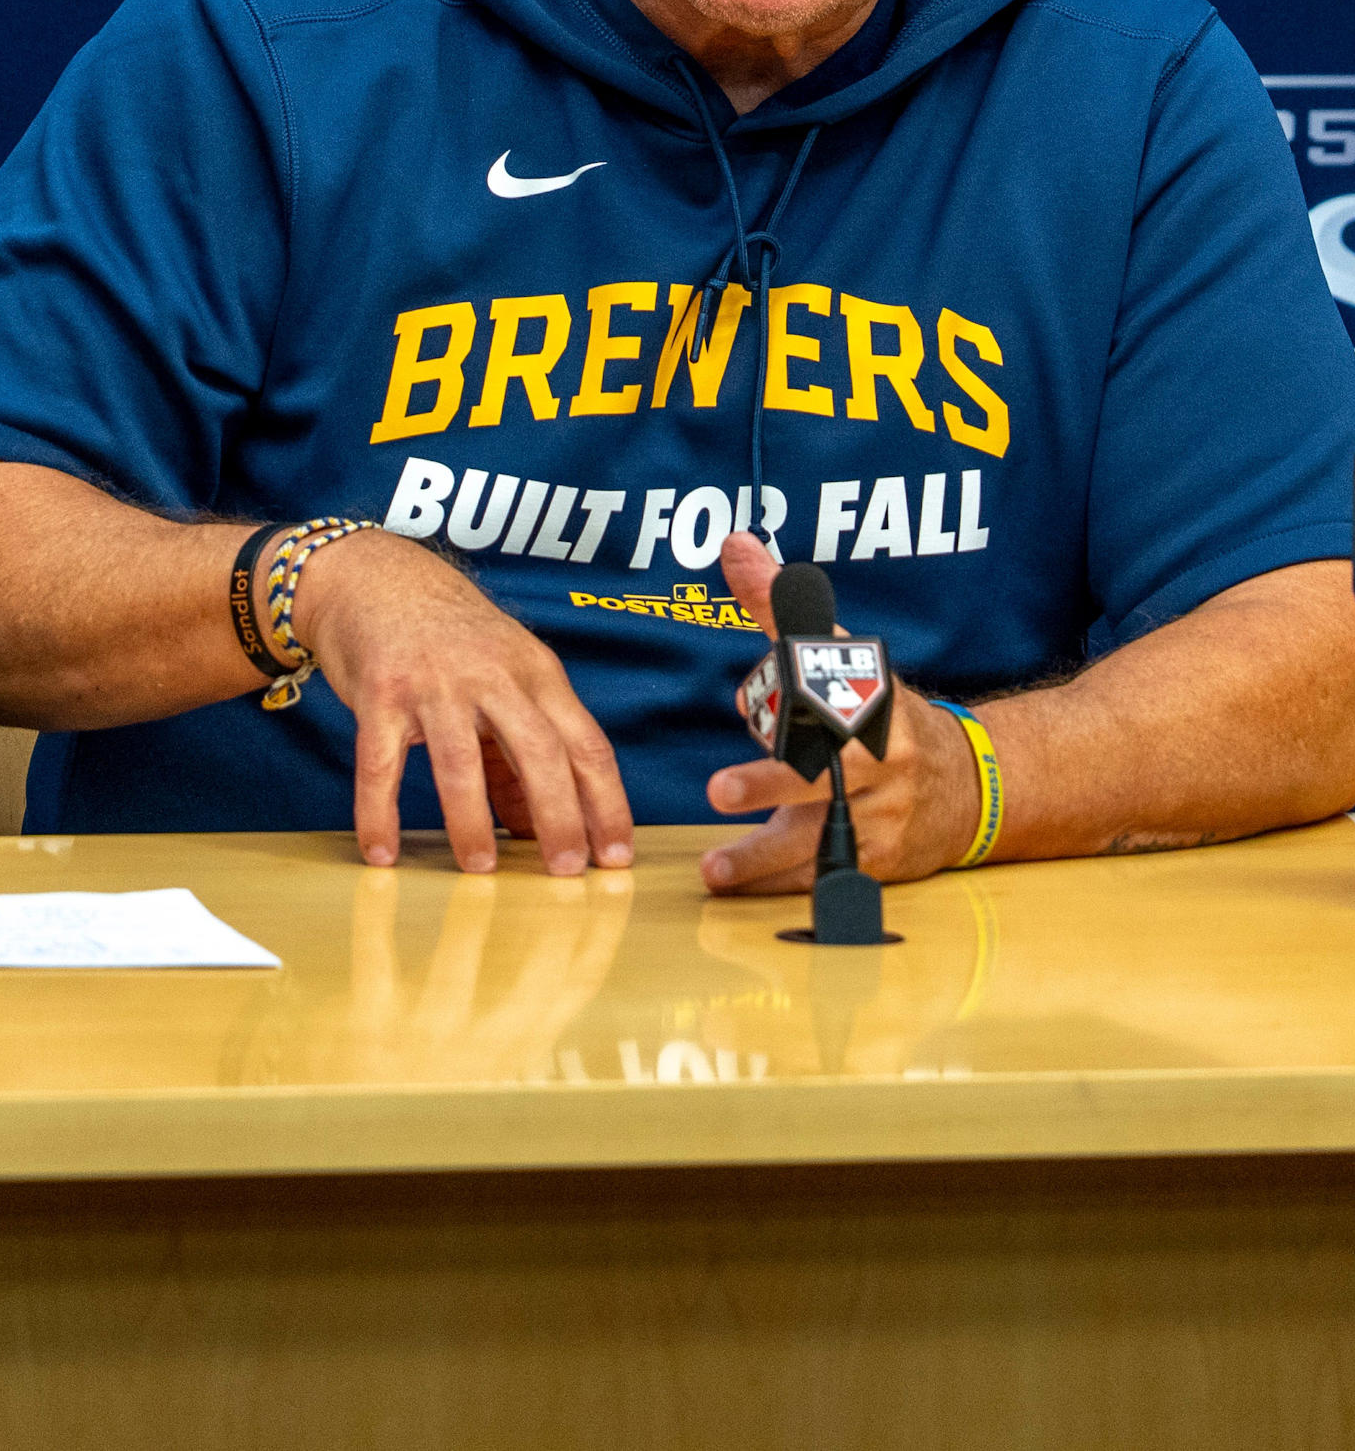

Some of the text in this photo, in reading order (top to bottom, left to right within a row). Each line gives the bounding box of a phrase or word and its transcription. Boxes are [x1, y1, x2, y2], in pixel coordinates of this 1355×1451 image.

[369, 280, 1011, 459] BREWERS
[382, 456, 990, 570] BUILT FOR FALL
[231, 569, 262, 654] Sandlot
[802, 647, 875, 671] MLB
